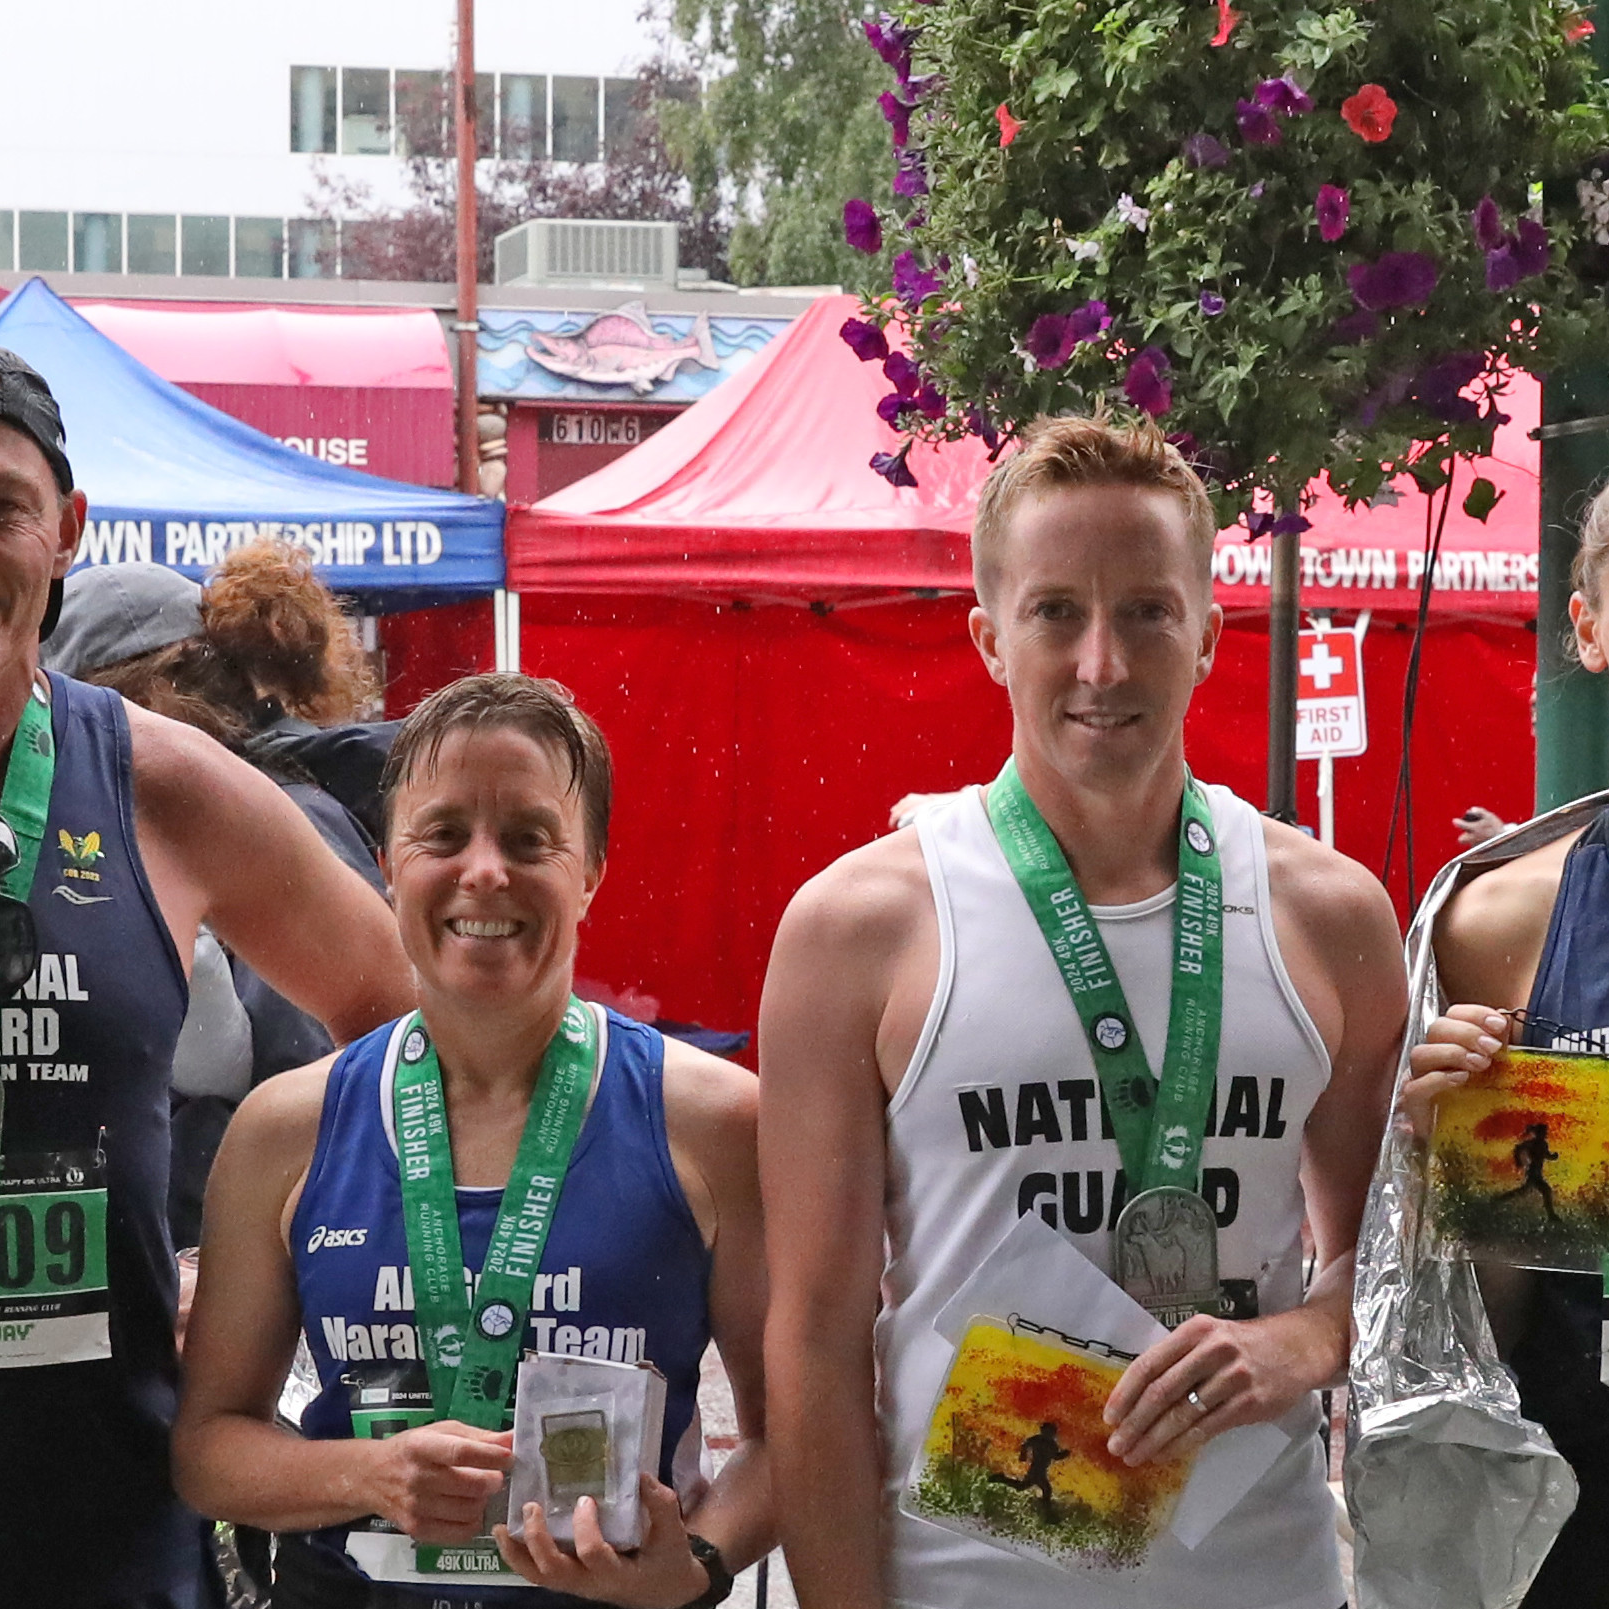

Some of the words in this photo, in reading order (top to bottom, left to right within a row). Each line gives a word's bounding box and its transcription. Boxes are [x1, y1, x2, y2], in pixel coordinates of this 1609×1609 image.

[283, 437, 368, 466] OUSE
[557, 417, 601, 441] 610
[382, 521, 443, 566] LTD
[1211, 545, 1397, 590] OWTOWN
[1407, 551, 1540, 592] PARTNERS
[1296, 705, 1352, 724] FIRST
[1310, 728, 1343, 744] AID
[1207, 881, 1220, 912] 2024
[1051, 886, 1112, 991] FINISHER
[1179, 871, 1206, 976] FINISHER
[1205, 914, 1218, 938] 49K
[1053, 937, 1075, 964] 49K
[1065, 962, 1088, 994] 2024
[27, 1062, 89, 1083] TEAM
[423, 1079, 438, 1111] 2024
[428, 1113, 443, 1136] 49K
[537, 1066, 566, 1144] ANCHORAGE
[546, 1097, 568, 1154] RUNNING
[564, 1062, 579, 1095] CLUB
[957, 1075, 1288, 1152] NATIAL
[400, 1083, 431, 1182] FINISHER
[1017, 1167, 1241, 1235] GUAD
[488, 1242, 508, 1275] 2024
[499, 1213, 518, 1241] 49K
[505, 1174, 557, 1280] FINISHER
[419, 1202, 434, 1268] RUNNING
[427, 1273, 440, 1304] CLUB
[432, 1209, 452, 1297] ANCHORAGE
[530, 1317, 647, 1366] Team
[408, 1392, 433, 1400] UNITE
[436, 1554, 461, 1571] 49K
[463, 1554, 500, 1572] ULTRA
